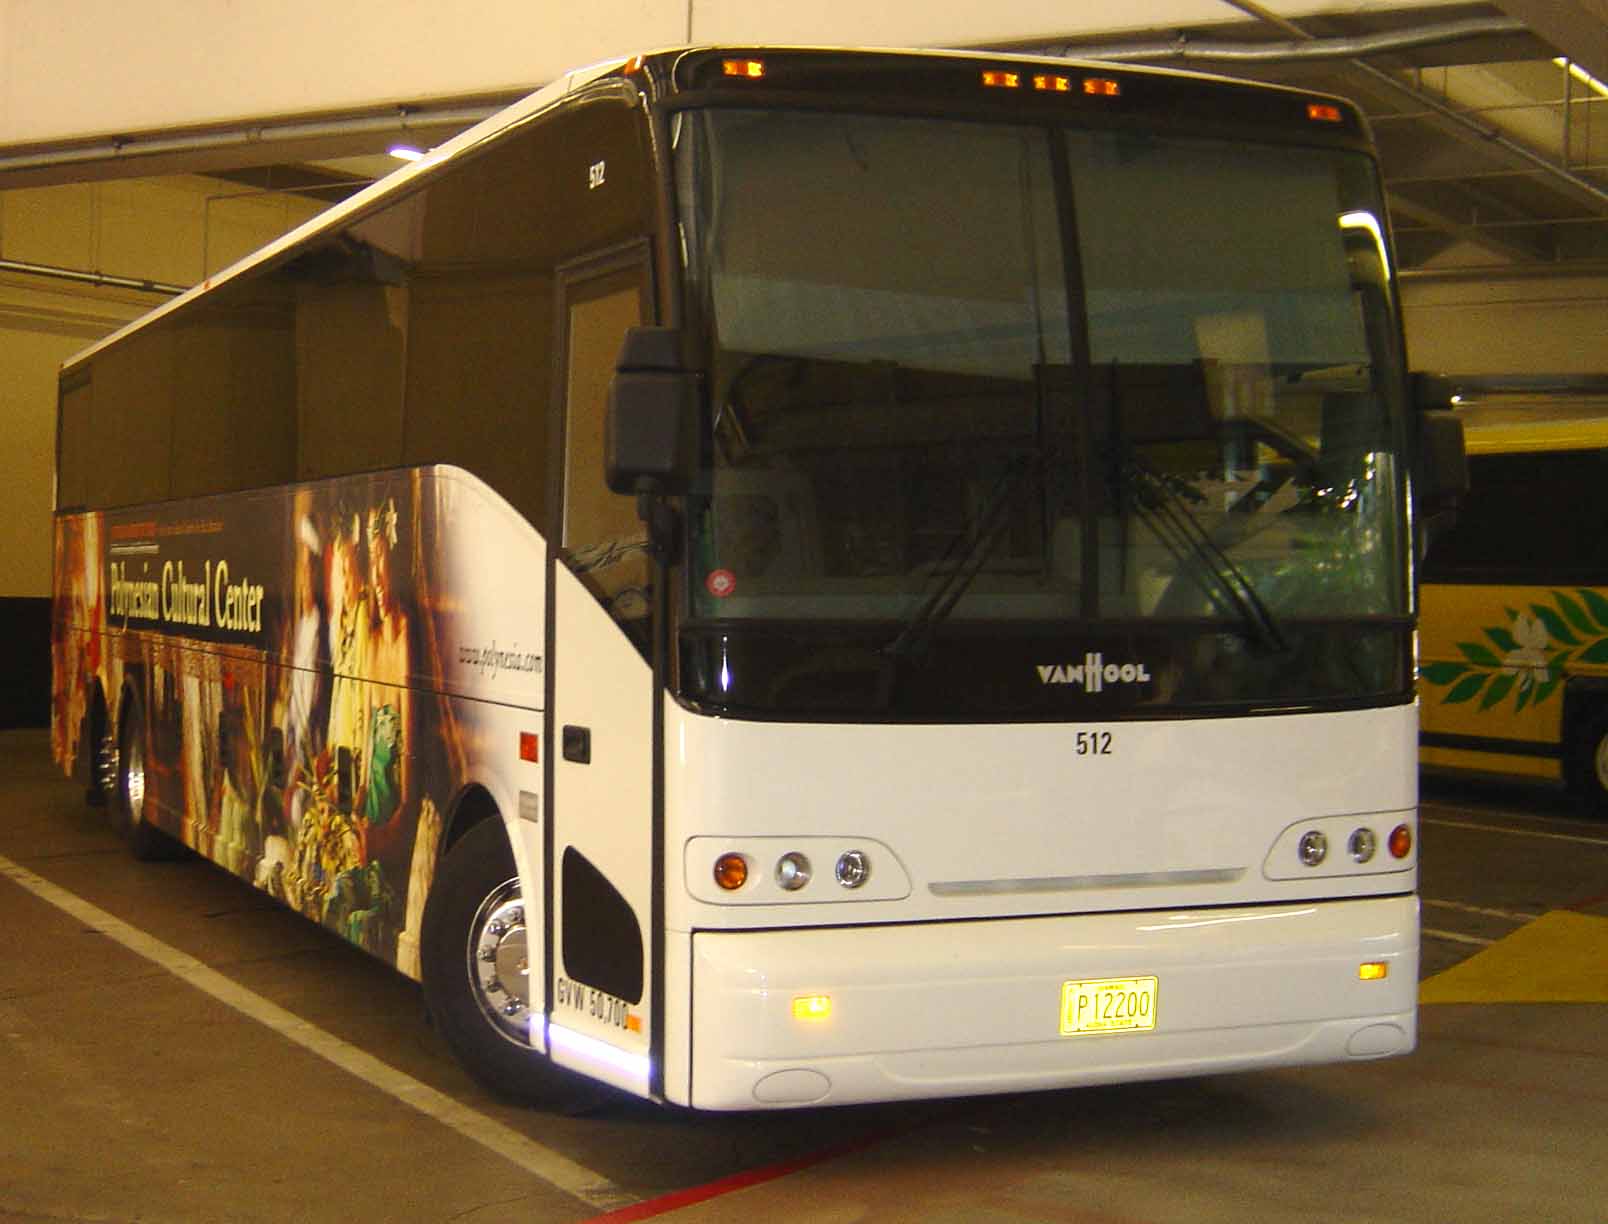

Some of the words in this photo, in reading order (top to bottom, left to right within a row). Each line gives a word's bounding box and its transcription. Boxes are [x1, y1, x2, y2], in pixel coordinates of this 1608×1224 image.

[589, 160, 606, 189] 512
[110, 560, 160, 632] Polynesian
[162, 559, 211, 626] Cultural
[215, 559, 264, 633] Center
[1075, 731, 1112, 755] 512
[558, 978, 585, 1010] GVW
[590, 990, 630, 1030] 50,700
[1077, 991, 1150, 1024] P12200
